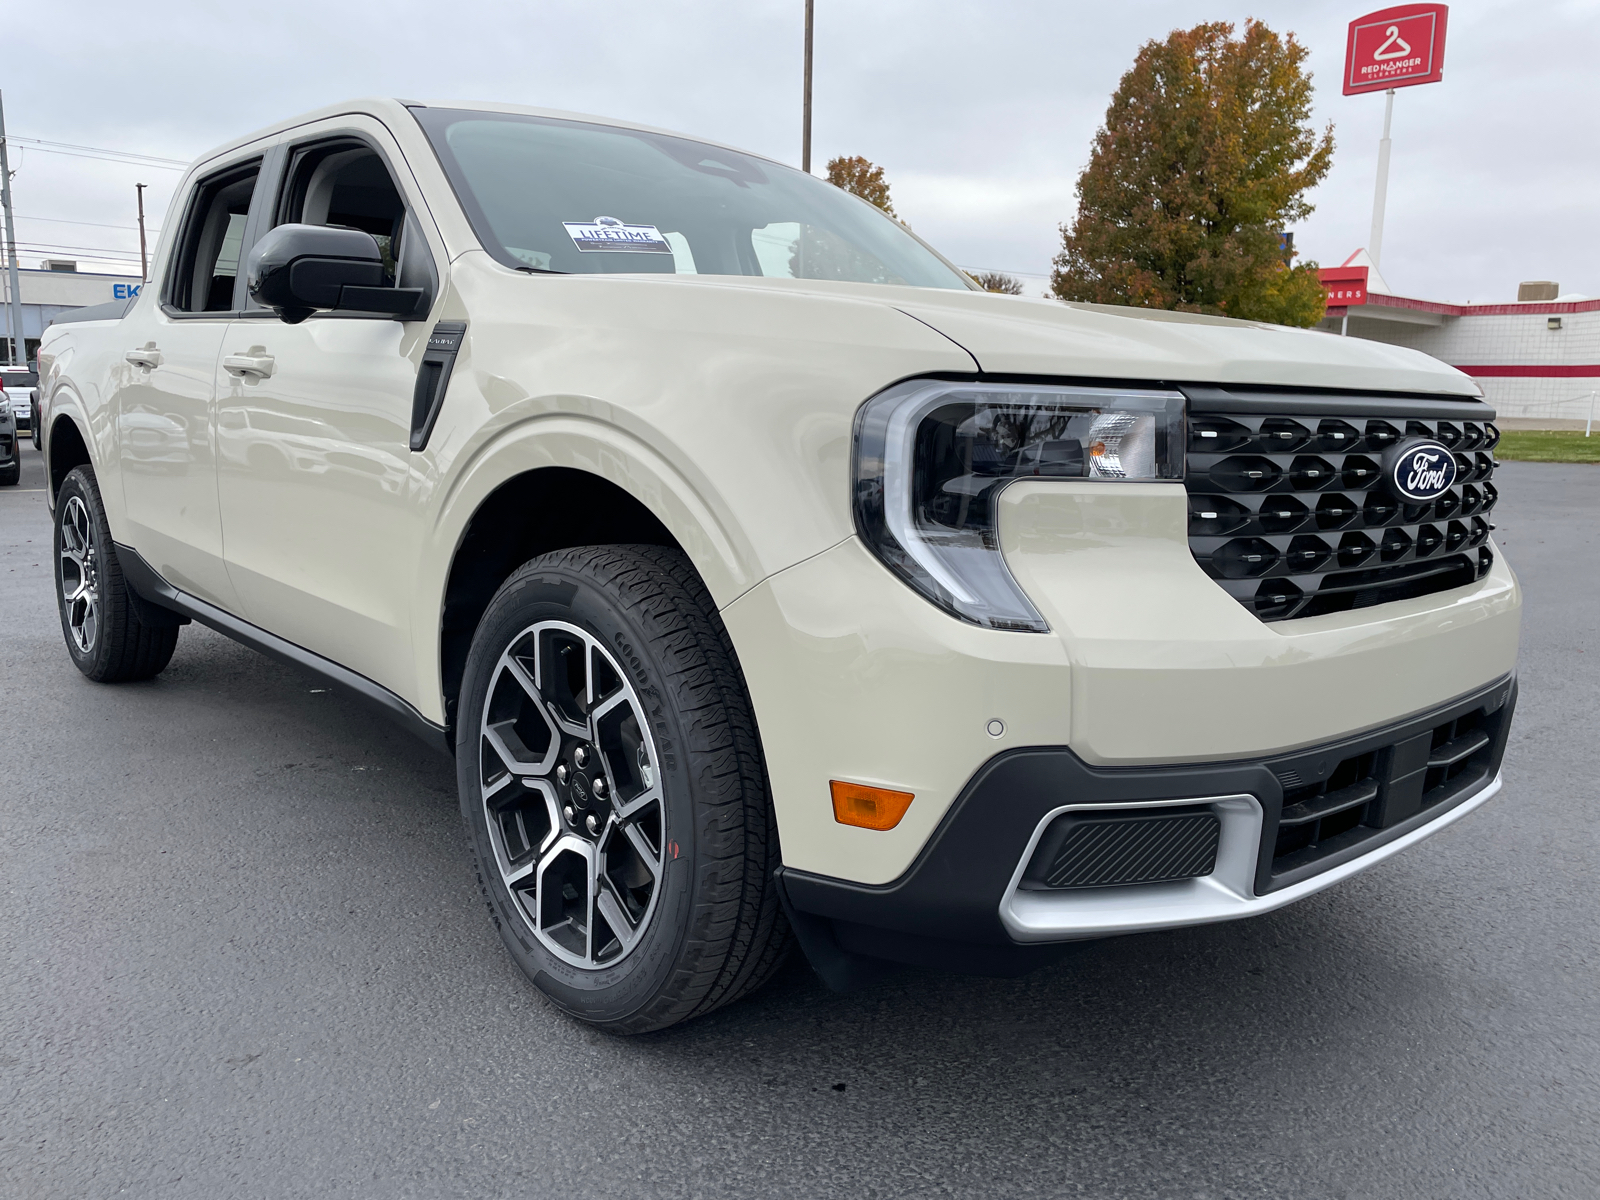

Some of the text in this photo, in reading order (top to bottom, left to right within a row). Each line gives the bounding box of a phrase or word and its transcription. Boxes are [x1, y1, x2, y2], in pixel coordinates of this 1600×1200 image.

[1361, 58, 1421, 74] RED HANGER
[1368, 67, 1413, 79] CLEANERS
[580, 230, 653, 241] LIFETIME
[113, 284, 141, 299] EK
[1319, 290, 1361, 299] NERS
[1407, 451, 1447, 490] Ford
